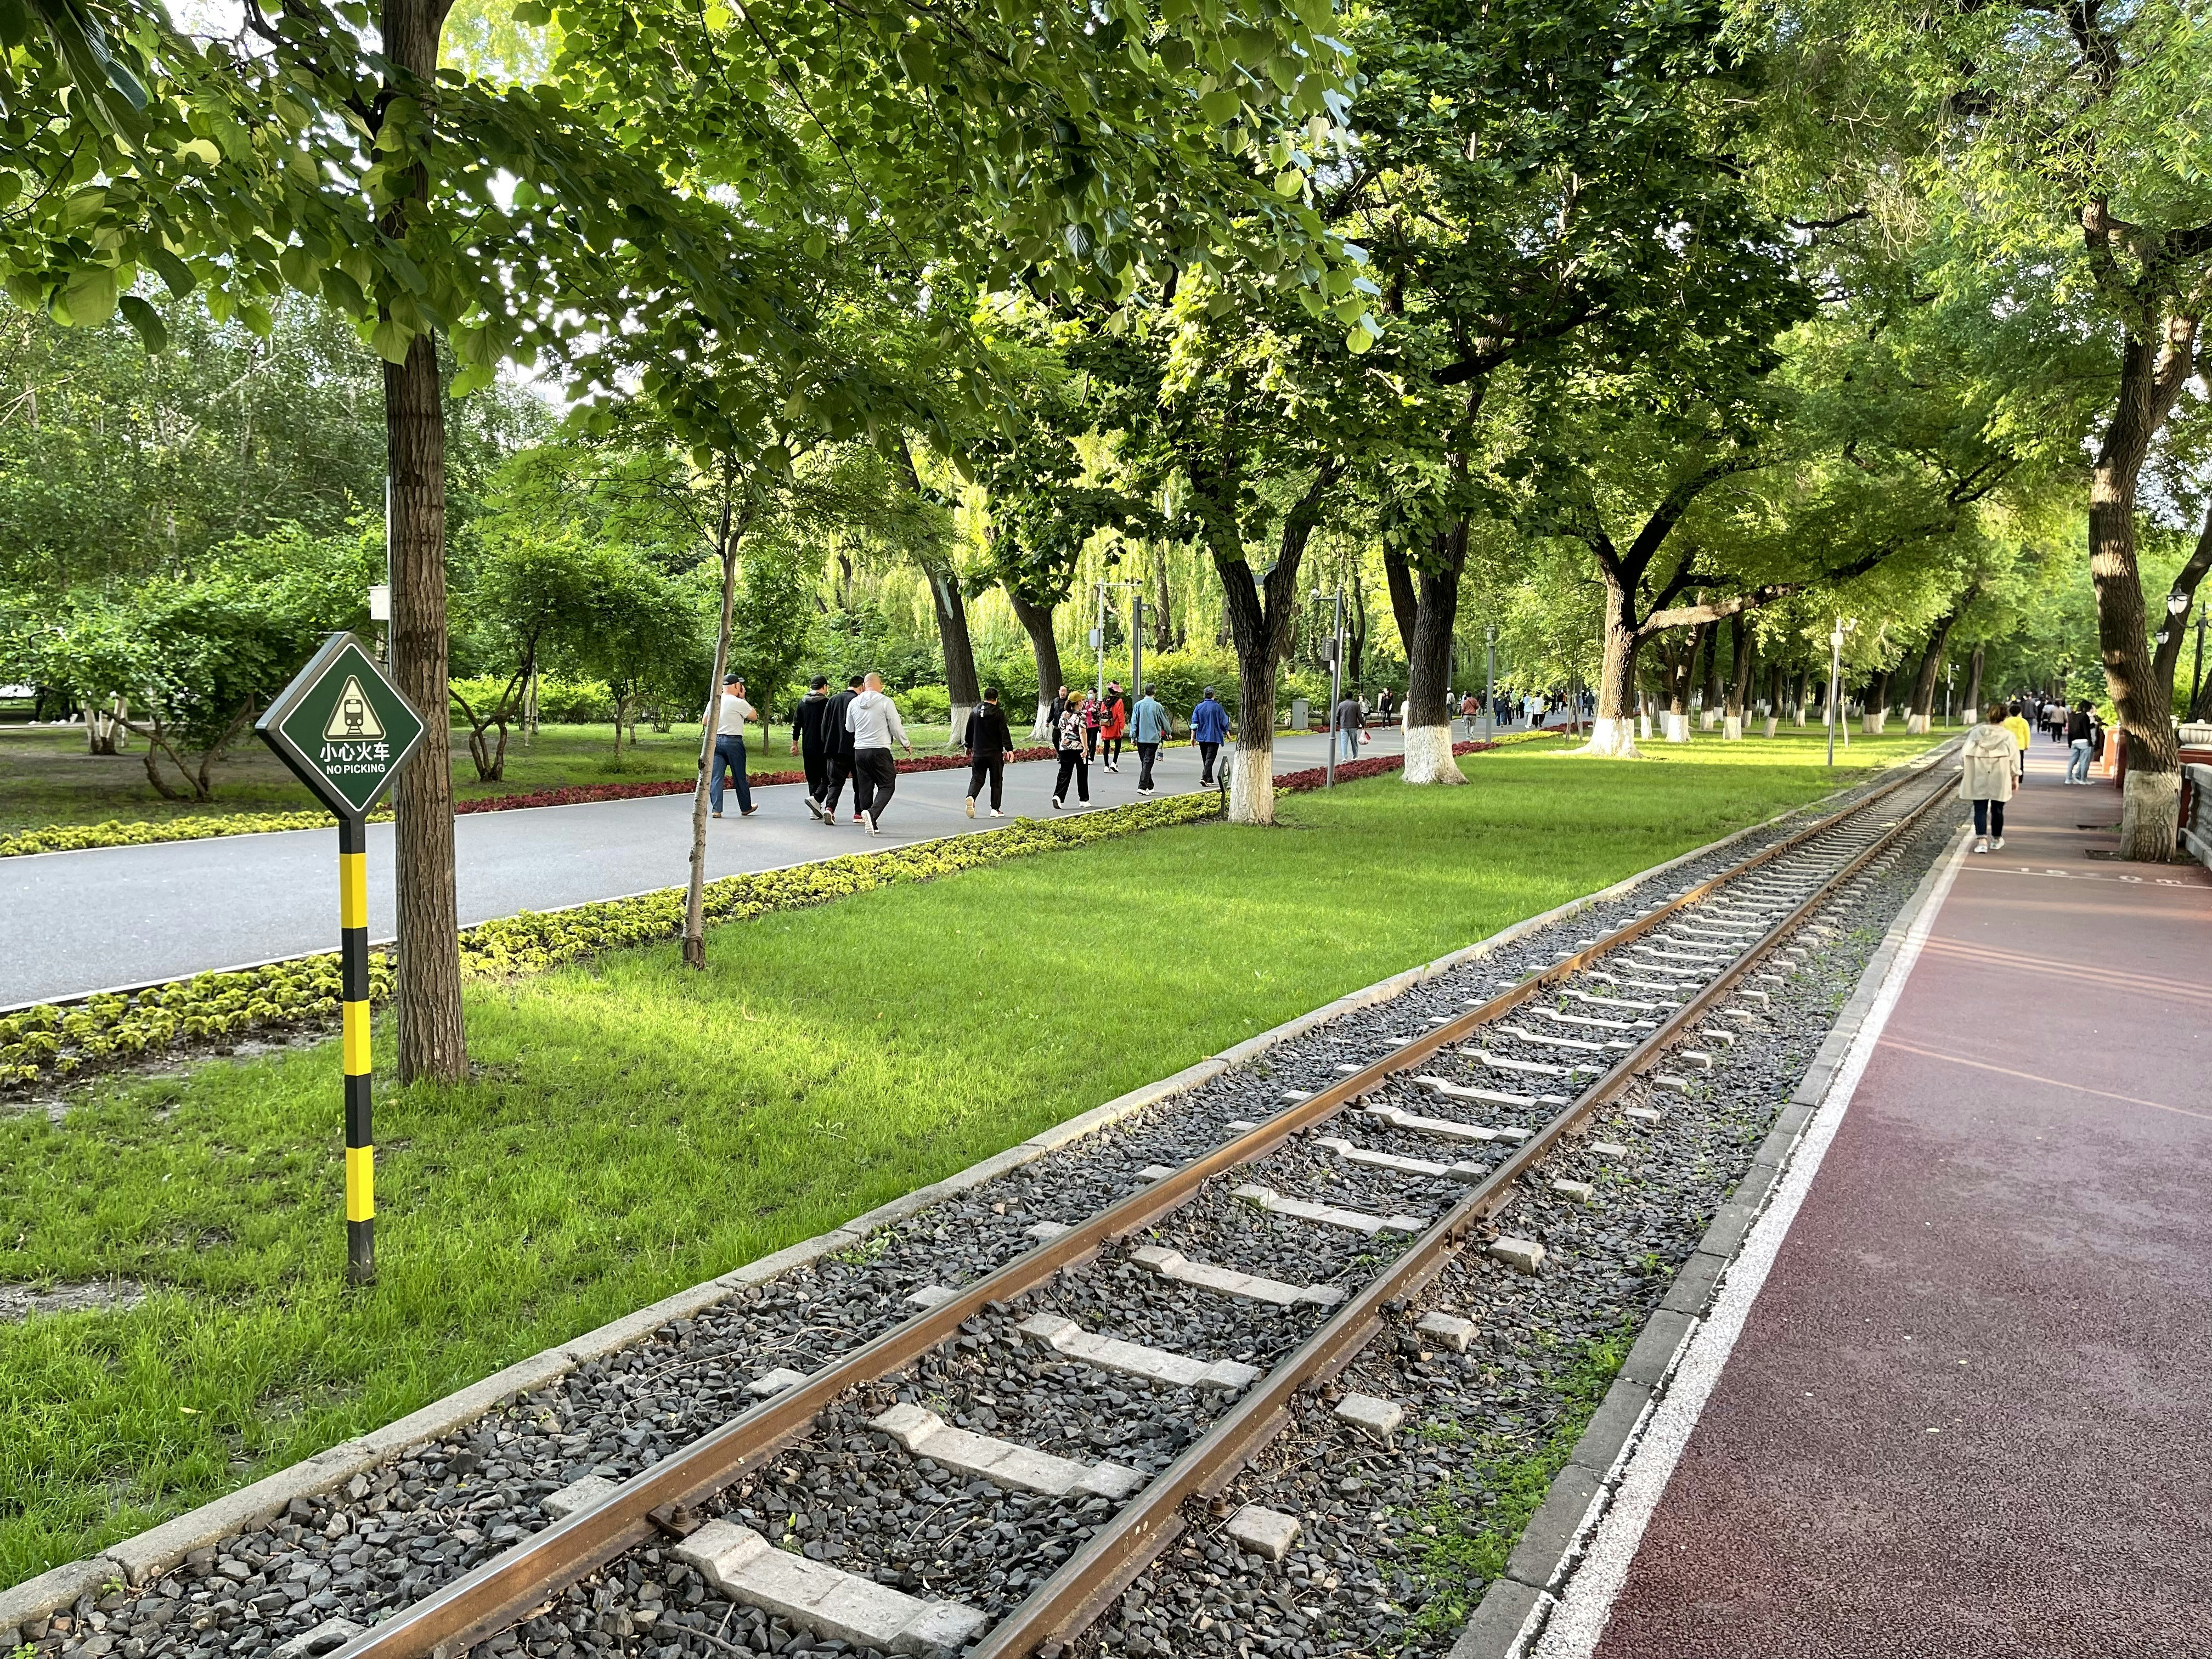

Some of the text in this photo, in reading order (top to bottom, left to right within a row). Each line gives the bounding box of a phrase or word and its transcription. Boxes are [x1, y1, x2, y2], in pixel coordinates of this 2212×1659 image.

[320, 742, 390, 763] 小心火车
[326, 763, 386, 775] NO PICKING
